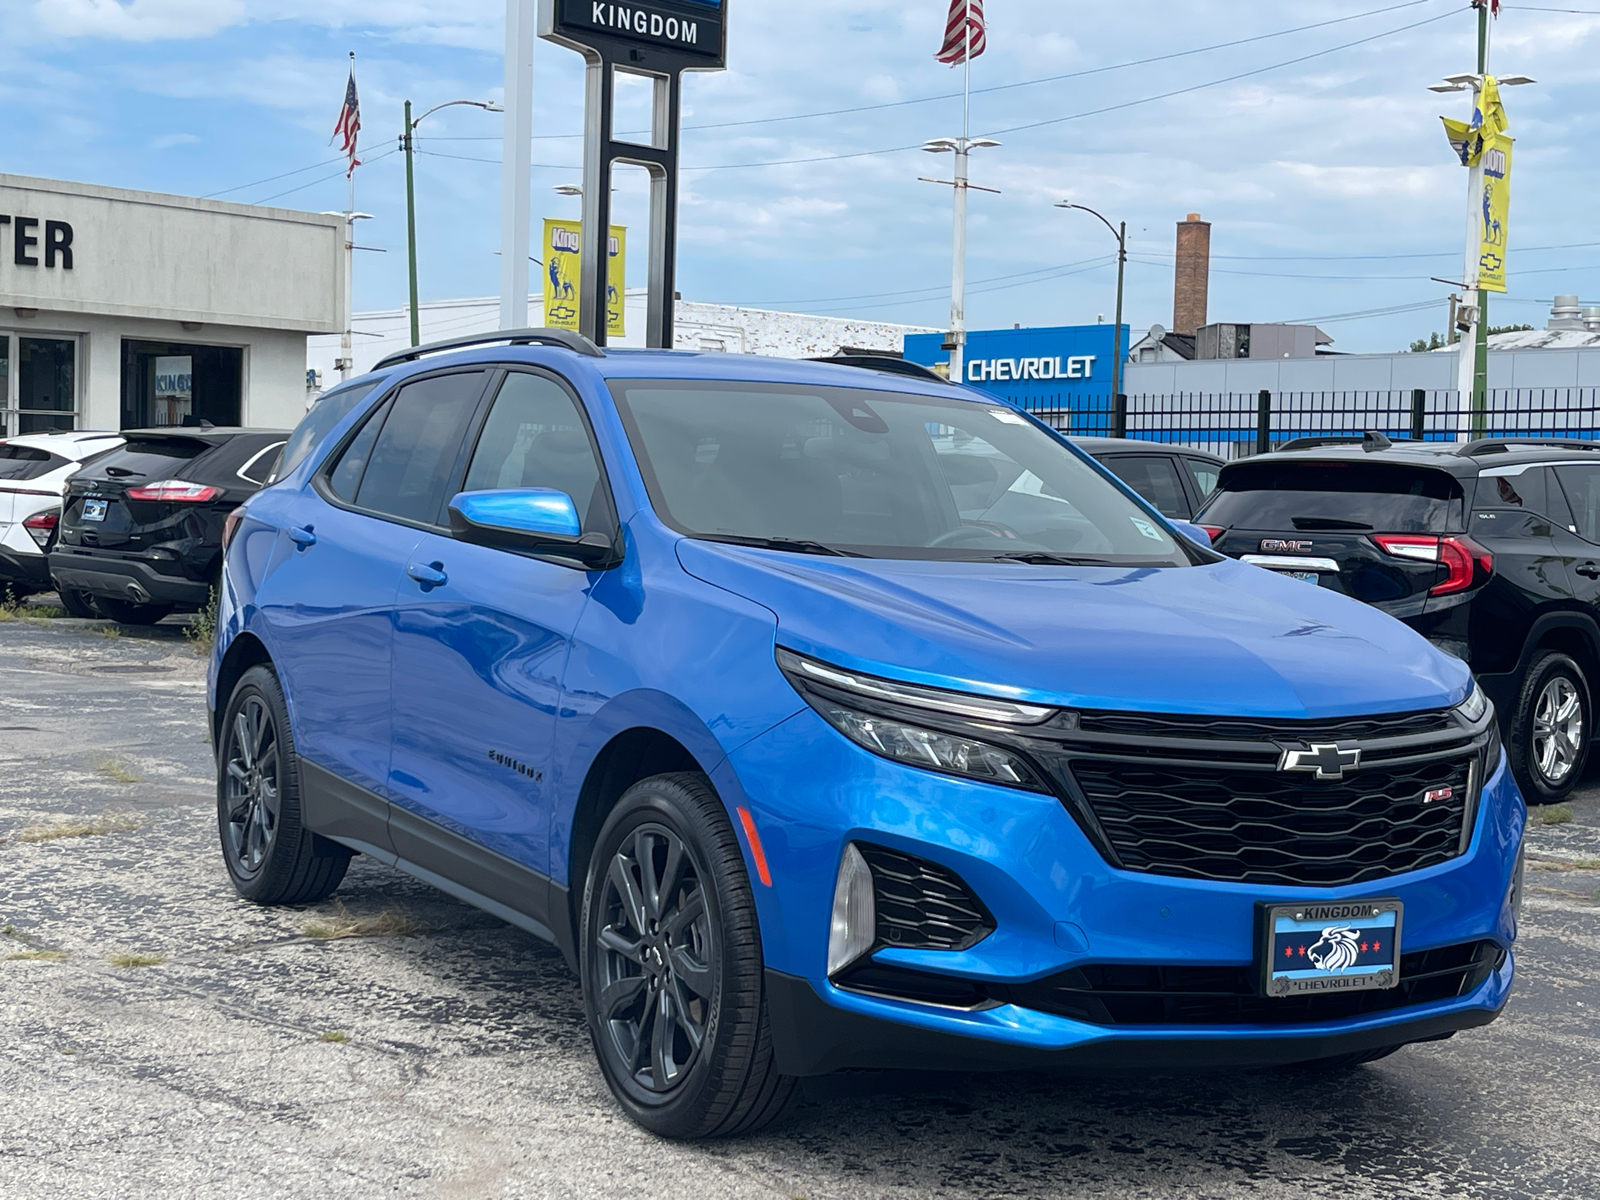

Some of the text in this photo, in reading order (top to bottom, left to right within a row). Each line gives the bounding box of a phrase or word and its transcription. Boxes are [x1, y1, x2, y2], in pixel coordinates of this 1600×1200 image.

[592, 1, 697, 44] KINGDOM
[551, 227, 579, 253] King
[967, 355, 1096, 381] CHEVROLET
[1261, 539, 1313, 553] GMC
[1423, 787, 1452, 803] RS
[1304, 905, 1372, 920] KINGDOM
